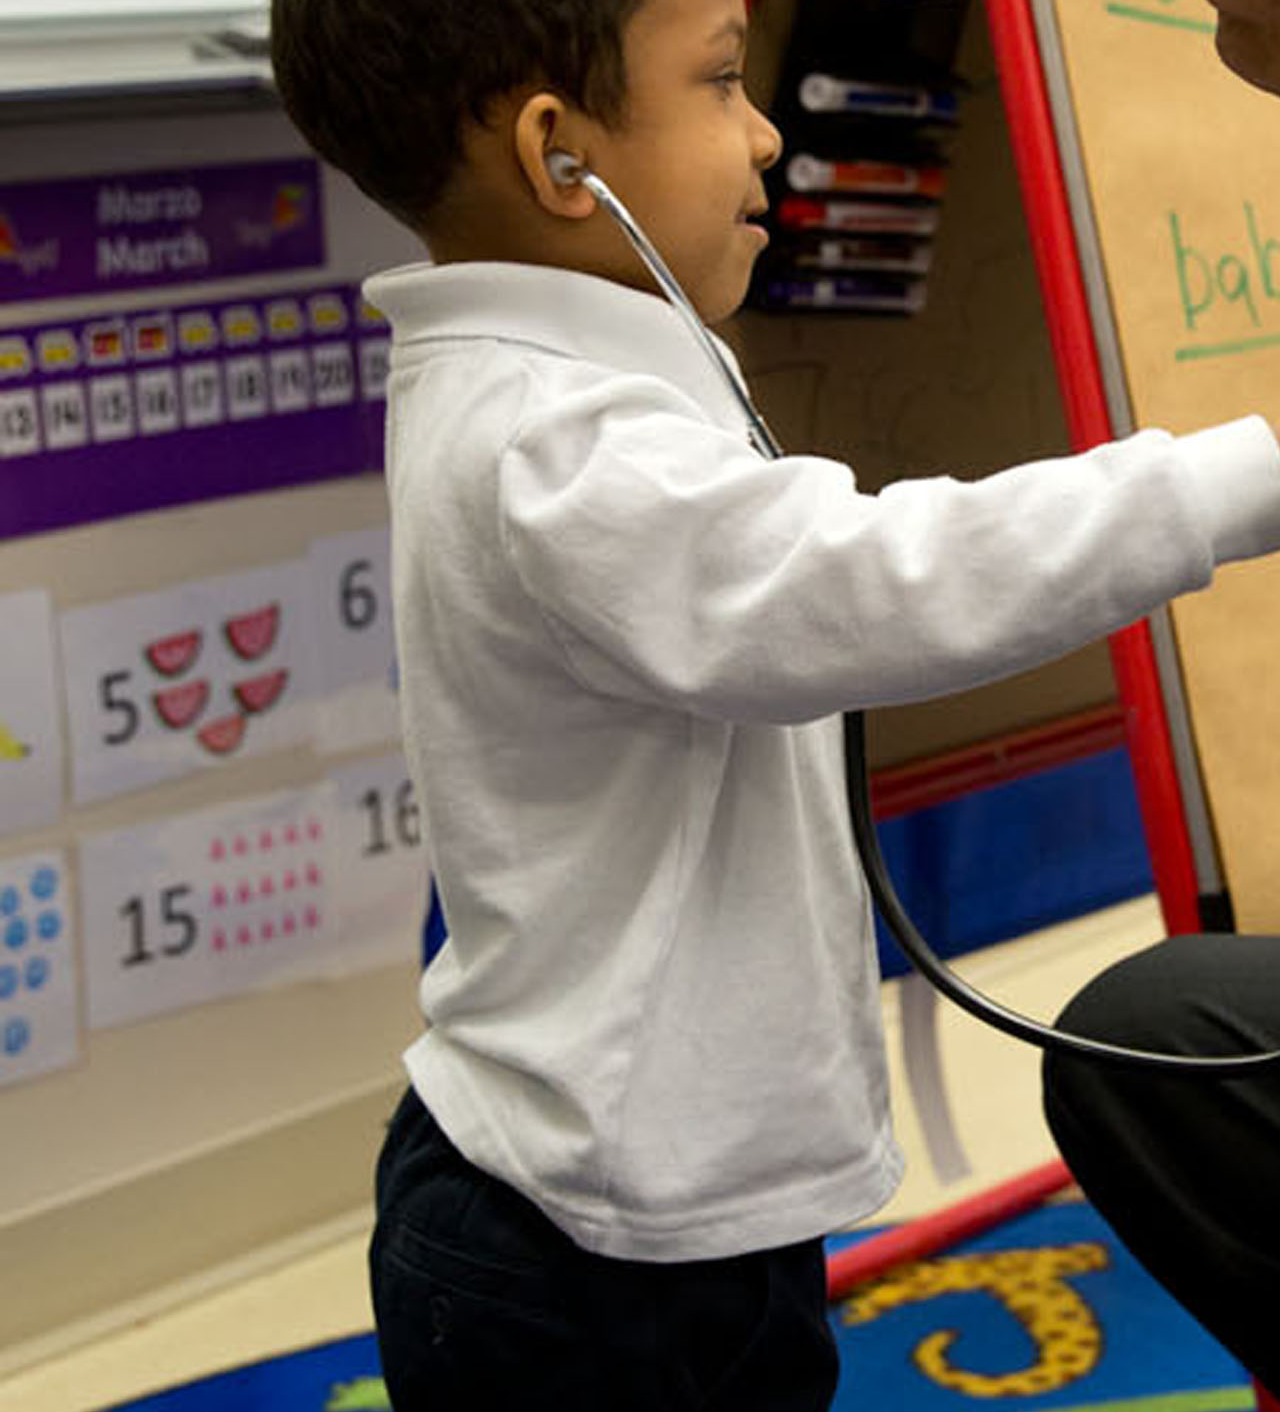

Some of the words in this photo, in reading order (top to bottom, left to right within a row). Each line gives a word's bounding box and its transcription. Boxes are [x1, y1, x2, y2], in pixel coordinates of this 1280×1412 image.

[96, 186, 202, 225] Marzo
[96, 230, 208, 277] March
[98, 670, 140, 746] 5
[338, 558, 378, 631] 6
[118, 883, 199, 968] 15
[357, 779, 422, 859] 16
